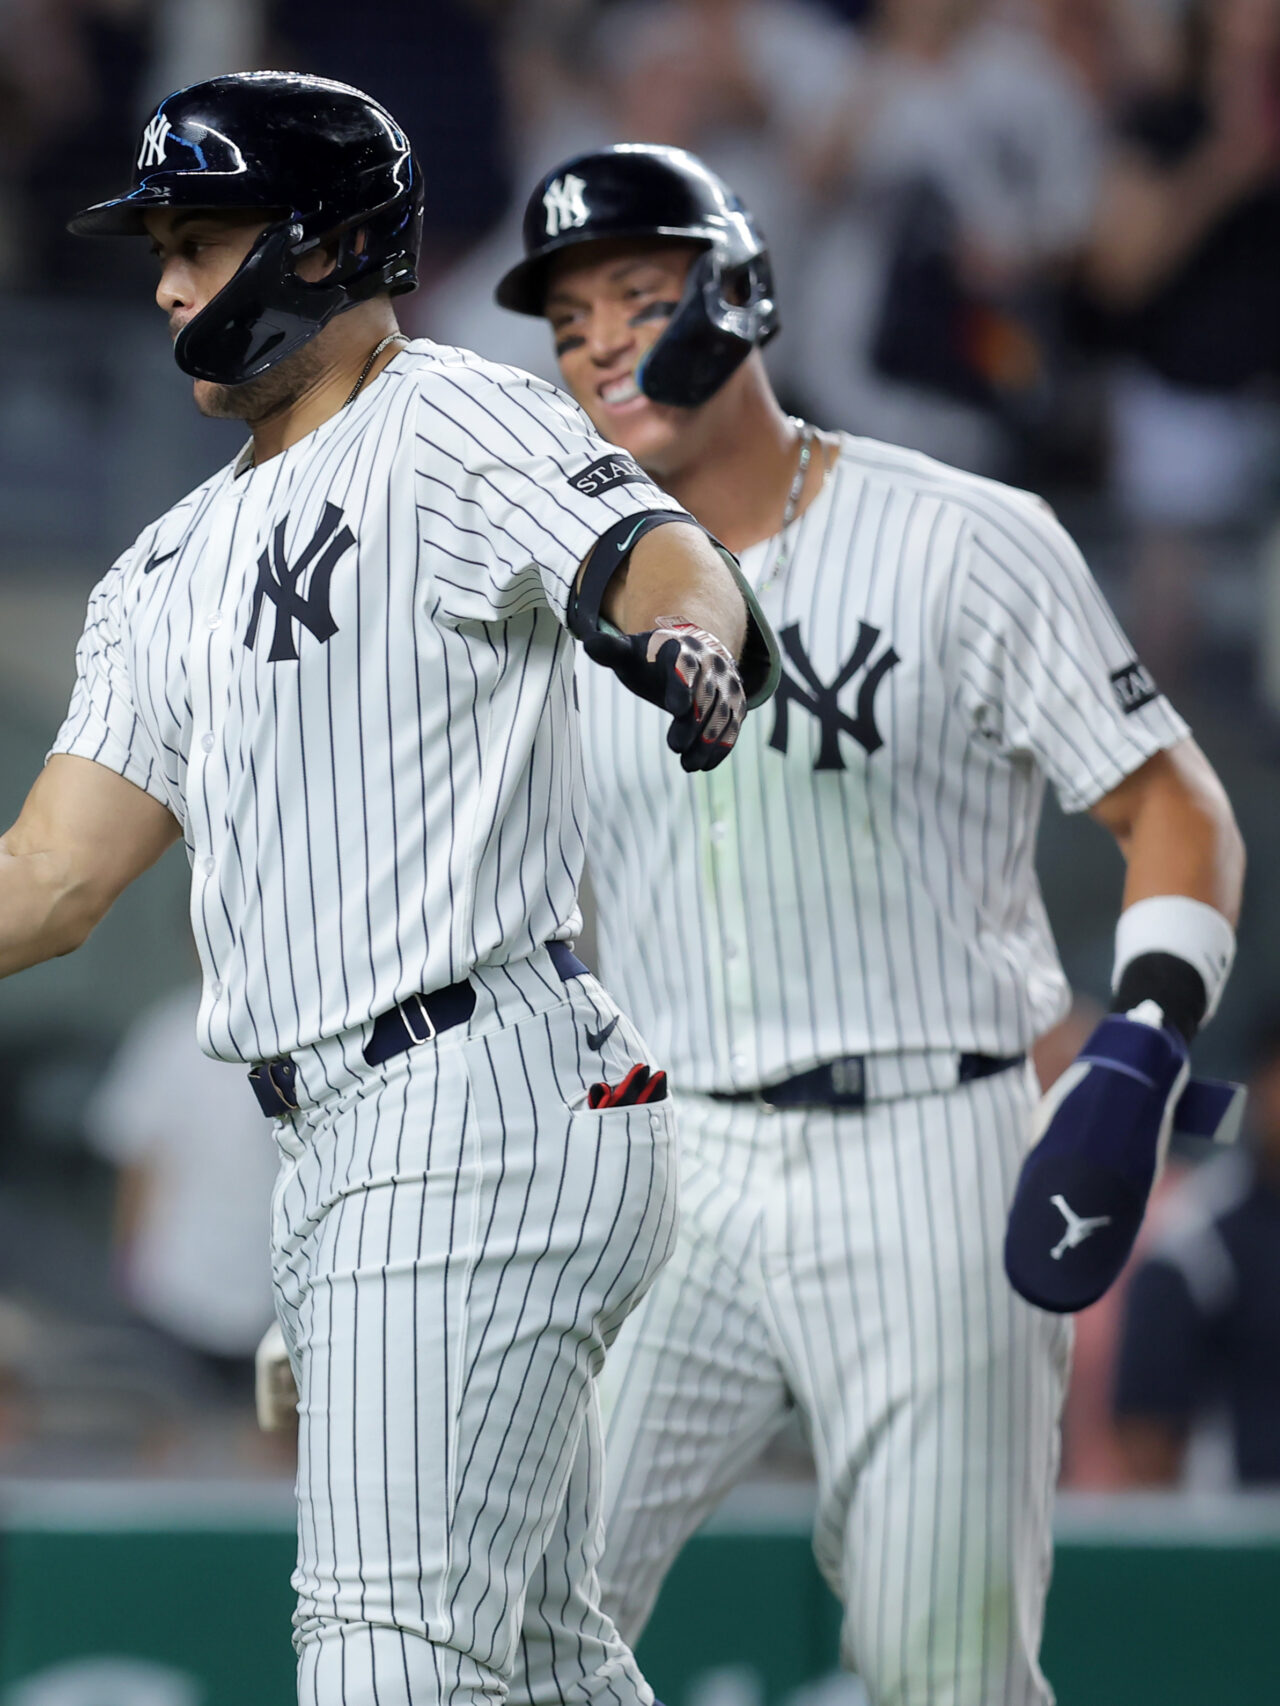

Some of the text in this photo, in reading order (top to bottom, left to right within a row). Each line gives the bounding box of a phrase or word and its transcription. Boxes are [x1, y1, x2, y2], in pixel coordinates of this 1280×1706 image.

[137, 113, 173, 170] NY
[543, 173, 591, 237] NY
[243, 500, 357, 663] NY
[769, 620, 901, 770] NY
